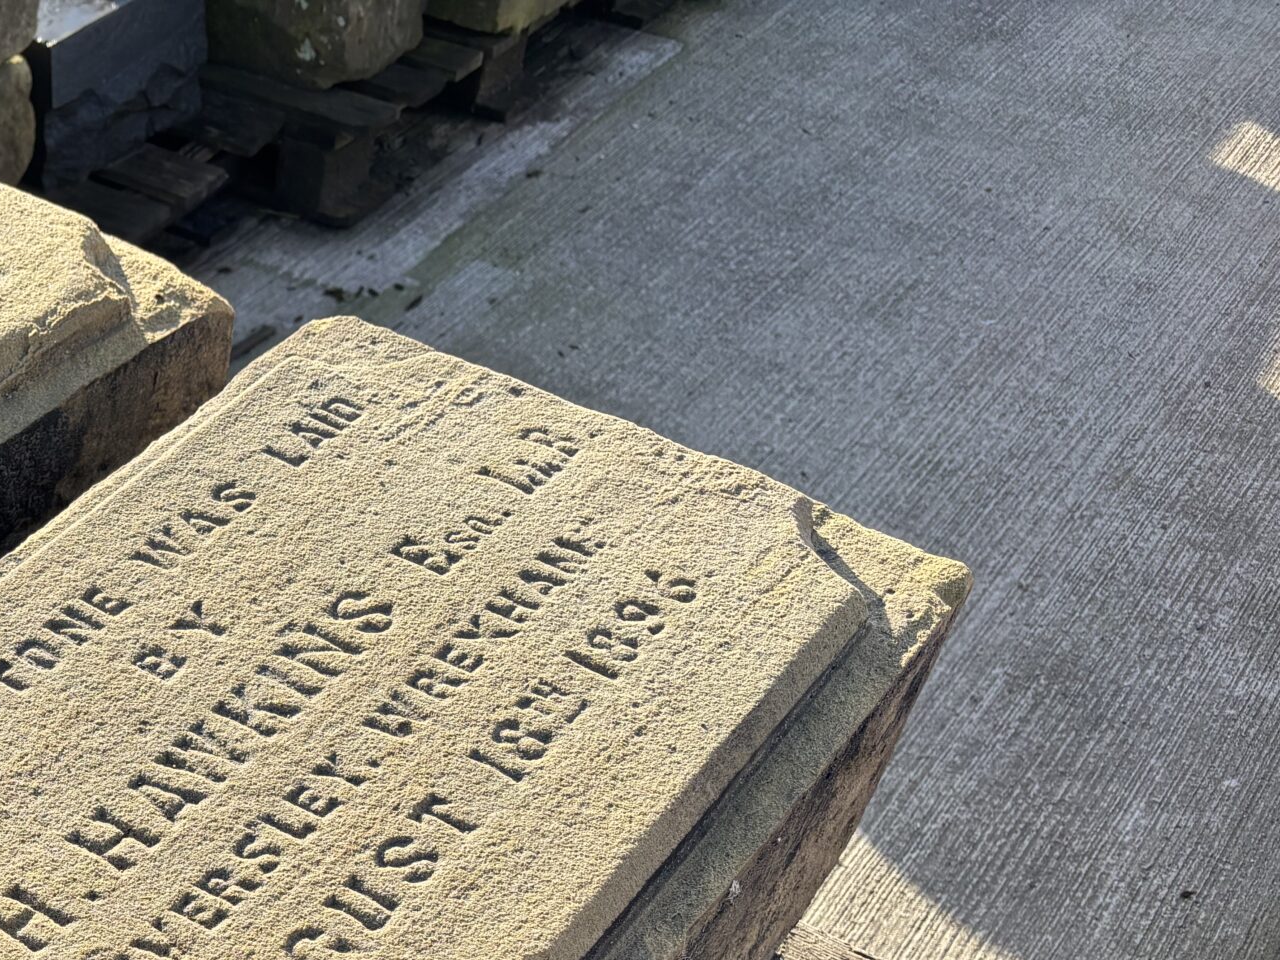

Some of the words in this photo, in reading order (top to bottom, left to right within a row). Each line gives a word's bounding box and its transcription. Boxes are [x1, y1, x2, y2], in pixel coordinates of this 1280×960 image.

[128, 481, 257, 569] WAS
[263, 397, 366, 468] LAID
[131, 599, 227, 682] BY
[563, 569, 698, 681] 1896
[66, 589, 394, 872] HAWKINS
